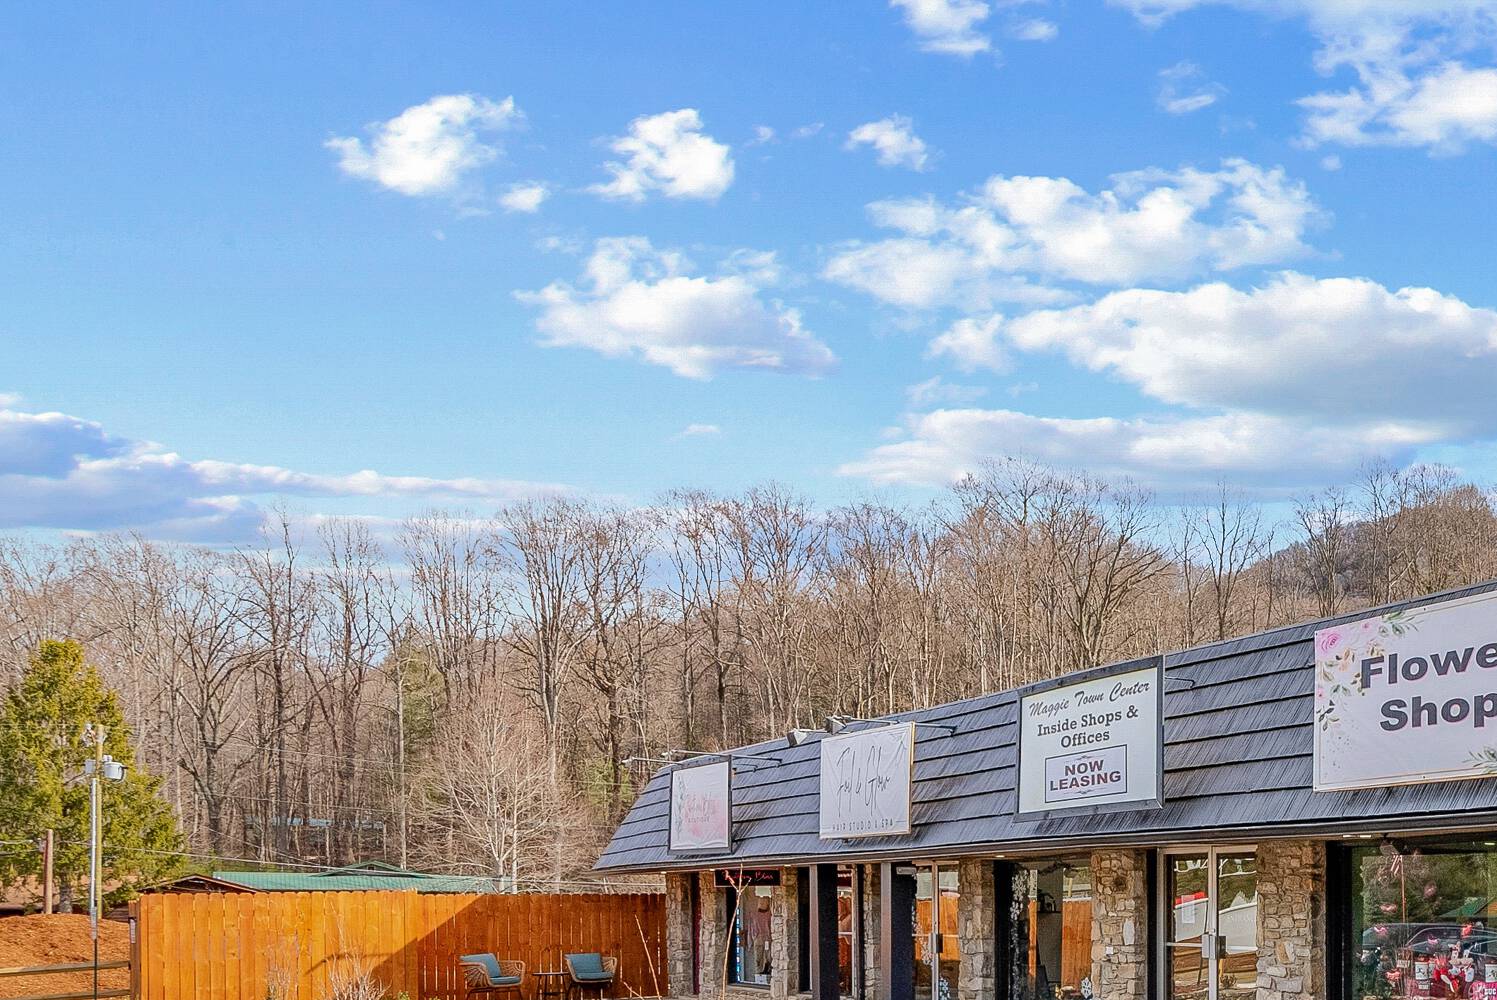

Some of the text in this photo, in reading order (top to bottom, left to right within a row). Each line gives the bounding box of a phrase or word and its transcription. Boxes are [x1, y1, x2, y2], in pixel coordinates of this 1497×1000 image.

[1029, 681, 1150, 718] Maggie Town Center
[1037, 705, 1139, 737] Inside Shops &
[1061, 730, 1110, 748] Offices
[1064, 759, 1104, 777] NOW
[1050, 770, 1121, 792] LEASING
[882, 818, 893, 829] SPA
